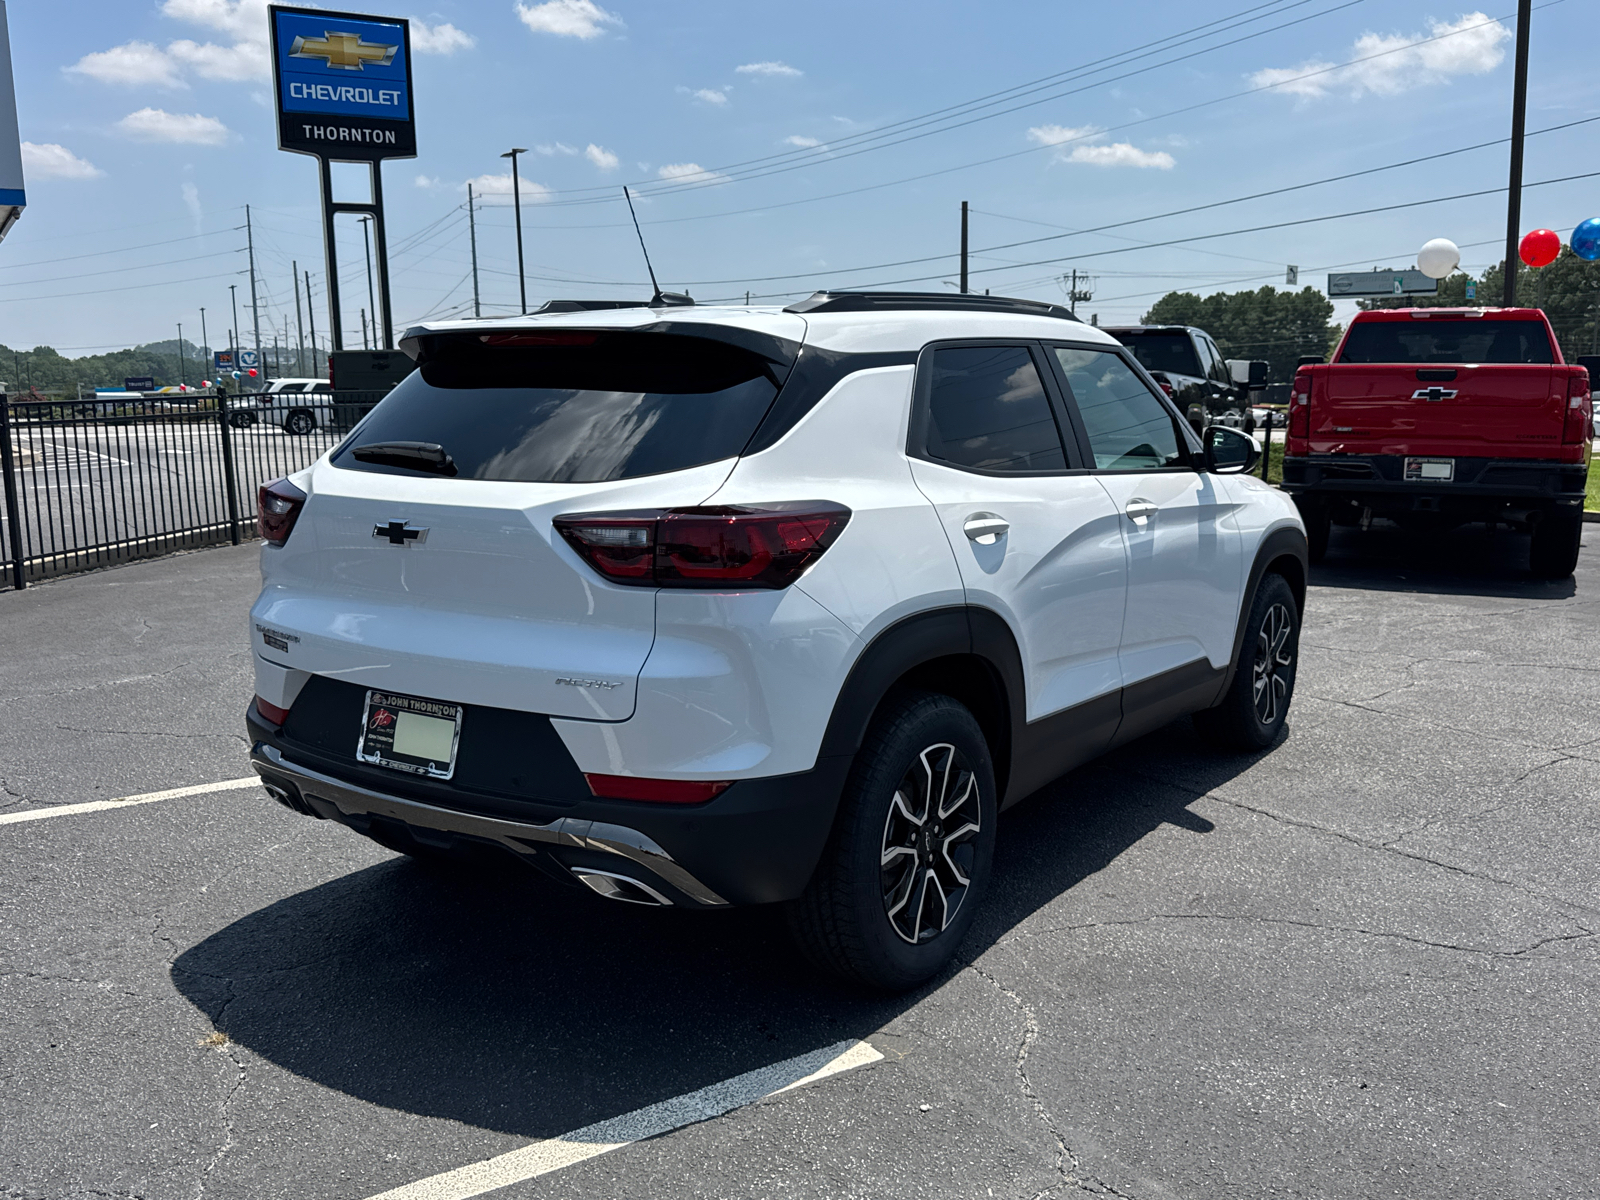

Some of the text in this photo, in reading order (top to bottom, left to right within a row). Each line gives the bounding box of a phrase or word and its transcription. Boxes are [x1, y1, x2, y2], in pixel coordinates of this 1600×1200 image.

[289, 82, 401, 106] CHEVROLET
[302, 124, 396, 144] THORNTON
[387, 696, 456, 716] JOHN THORNTON
